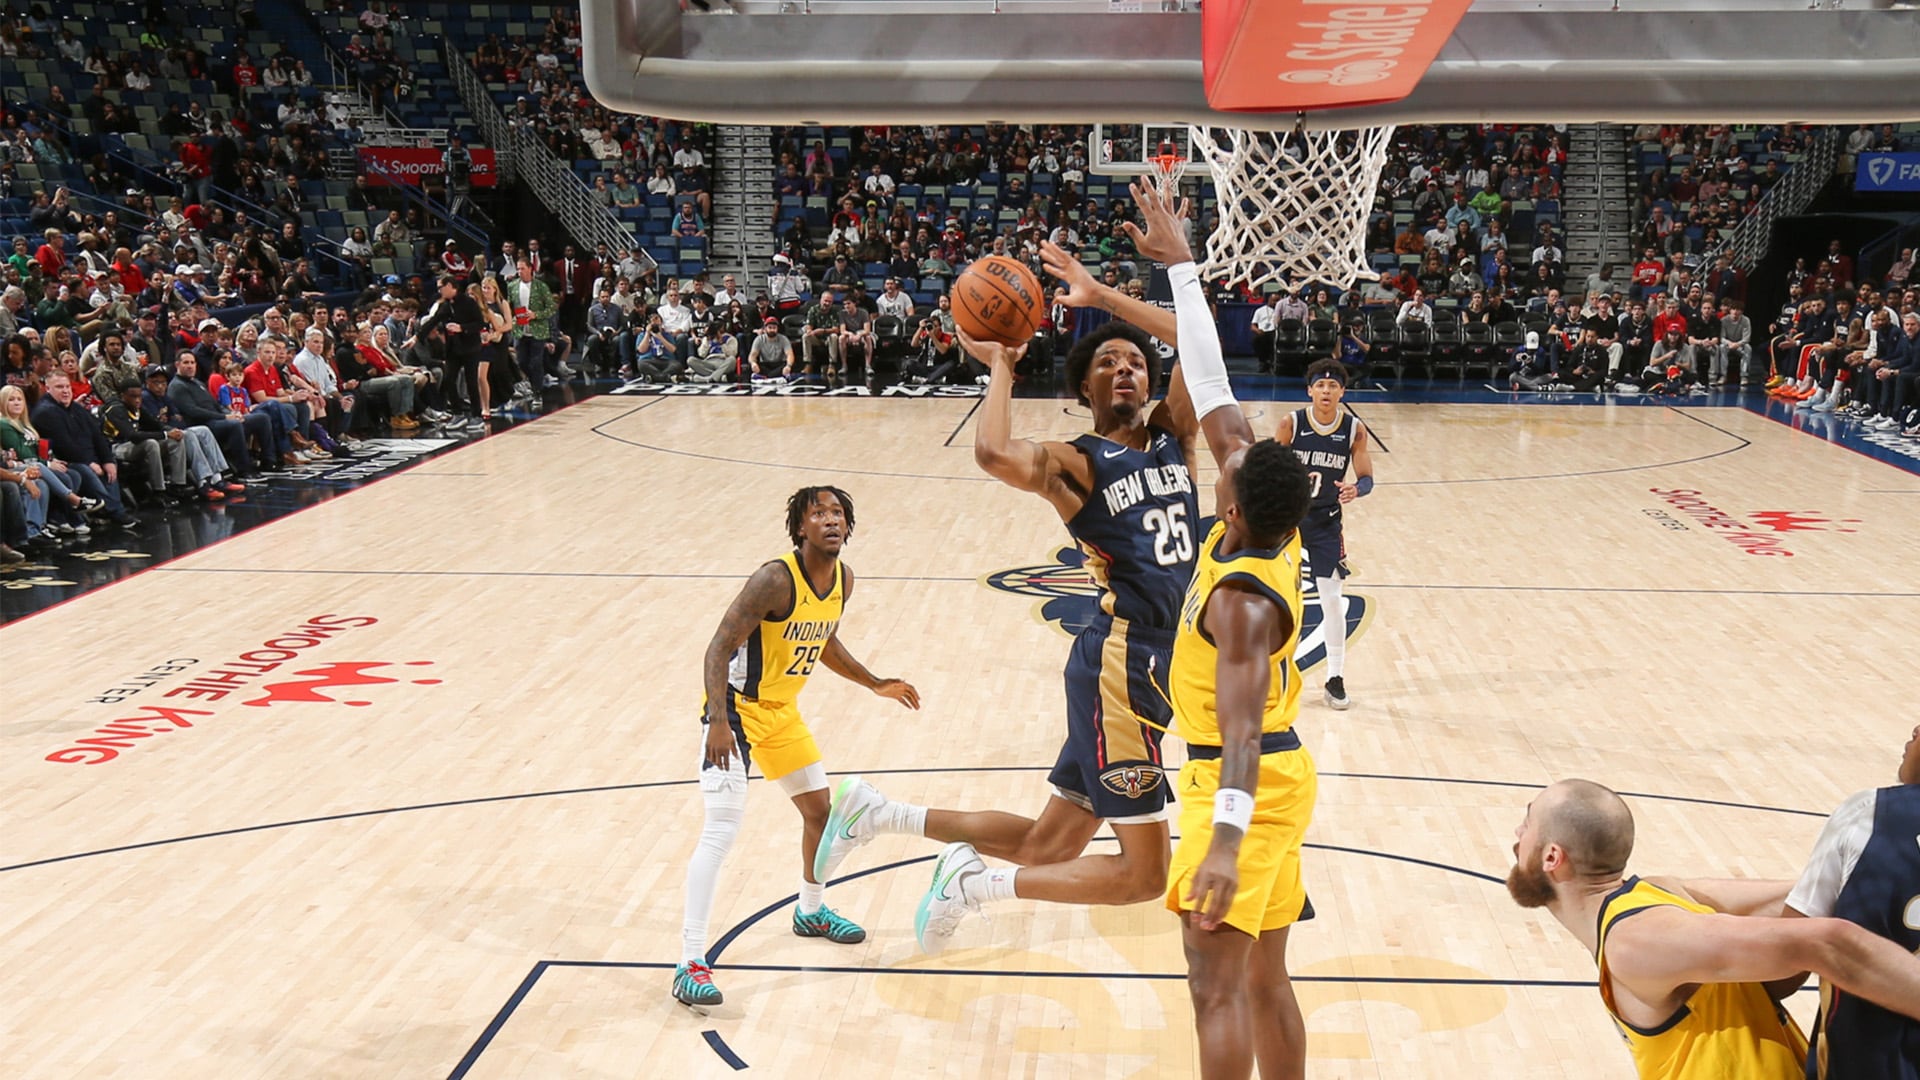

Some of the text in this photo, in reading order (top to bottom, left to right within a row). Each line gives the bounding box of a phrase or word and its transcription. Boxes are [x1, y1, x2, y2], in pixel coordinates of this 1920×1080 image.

[391, 160, 444, 175] SMOOTH
[609, 383, 987, 396] PELICANS
[1311, 451, 1346, 470] ORLEANS
[1102, 470, 1145, 517] NEW
[1649, 488, 1750, 529] SMOOTHIE
[1142, 502, 1193, 566] 25
[162, 614, 379, 701] SMOOTHIE
[785, 646, 820, 675] 29
[85, 657, 199, 704] CENTER
